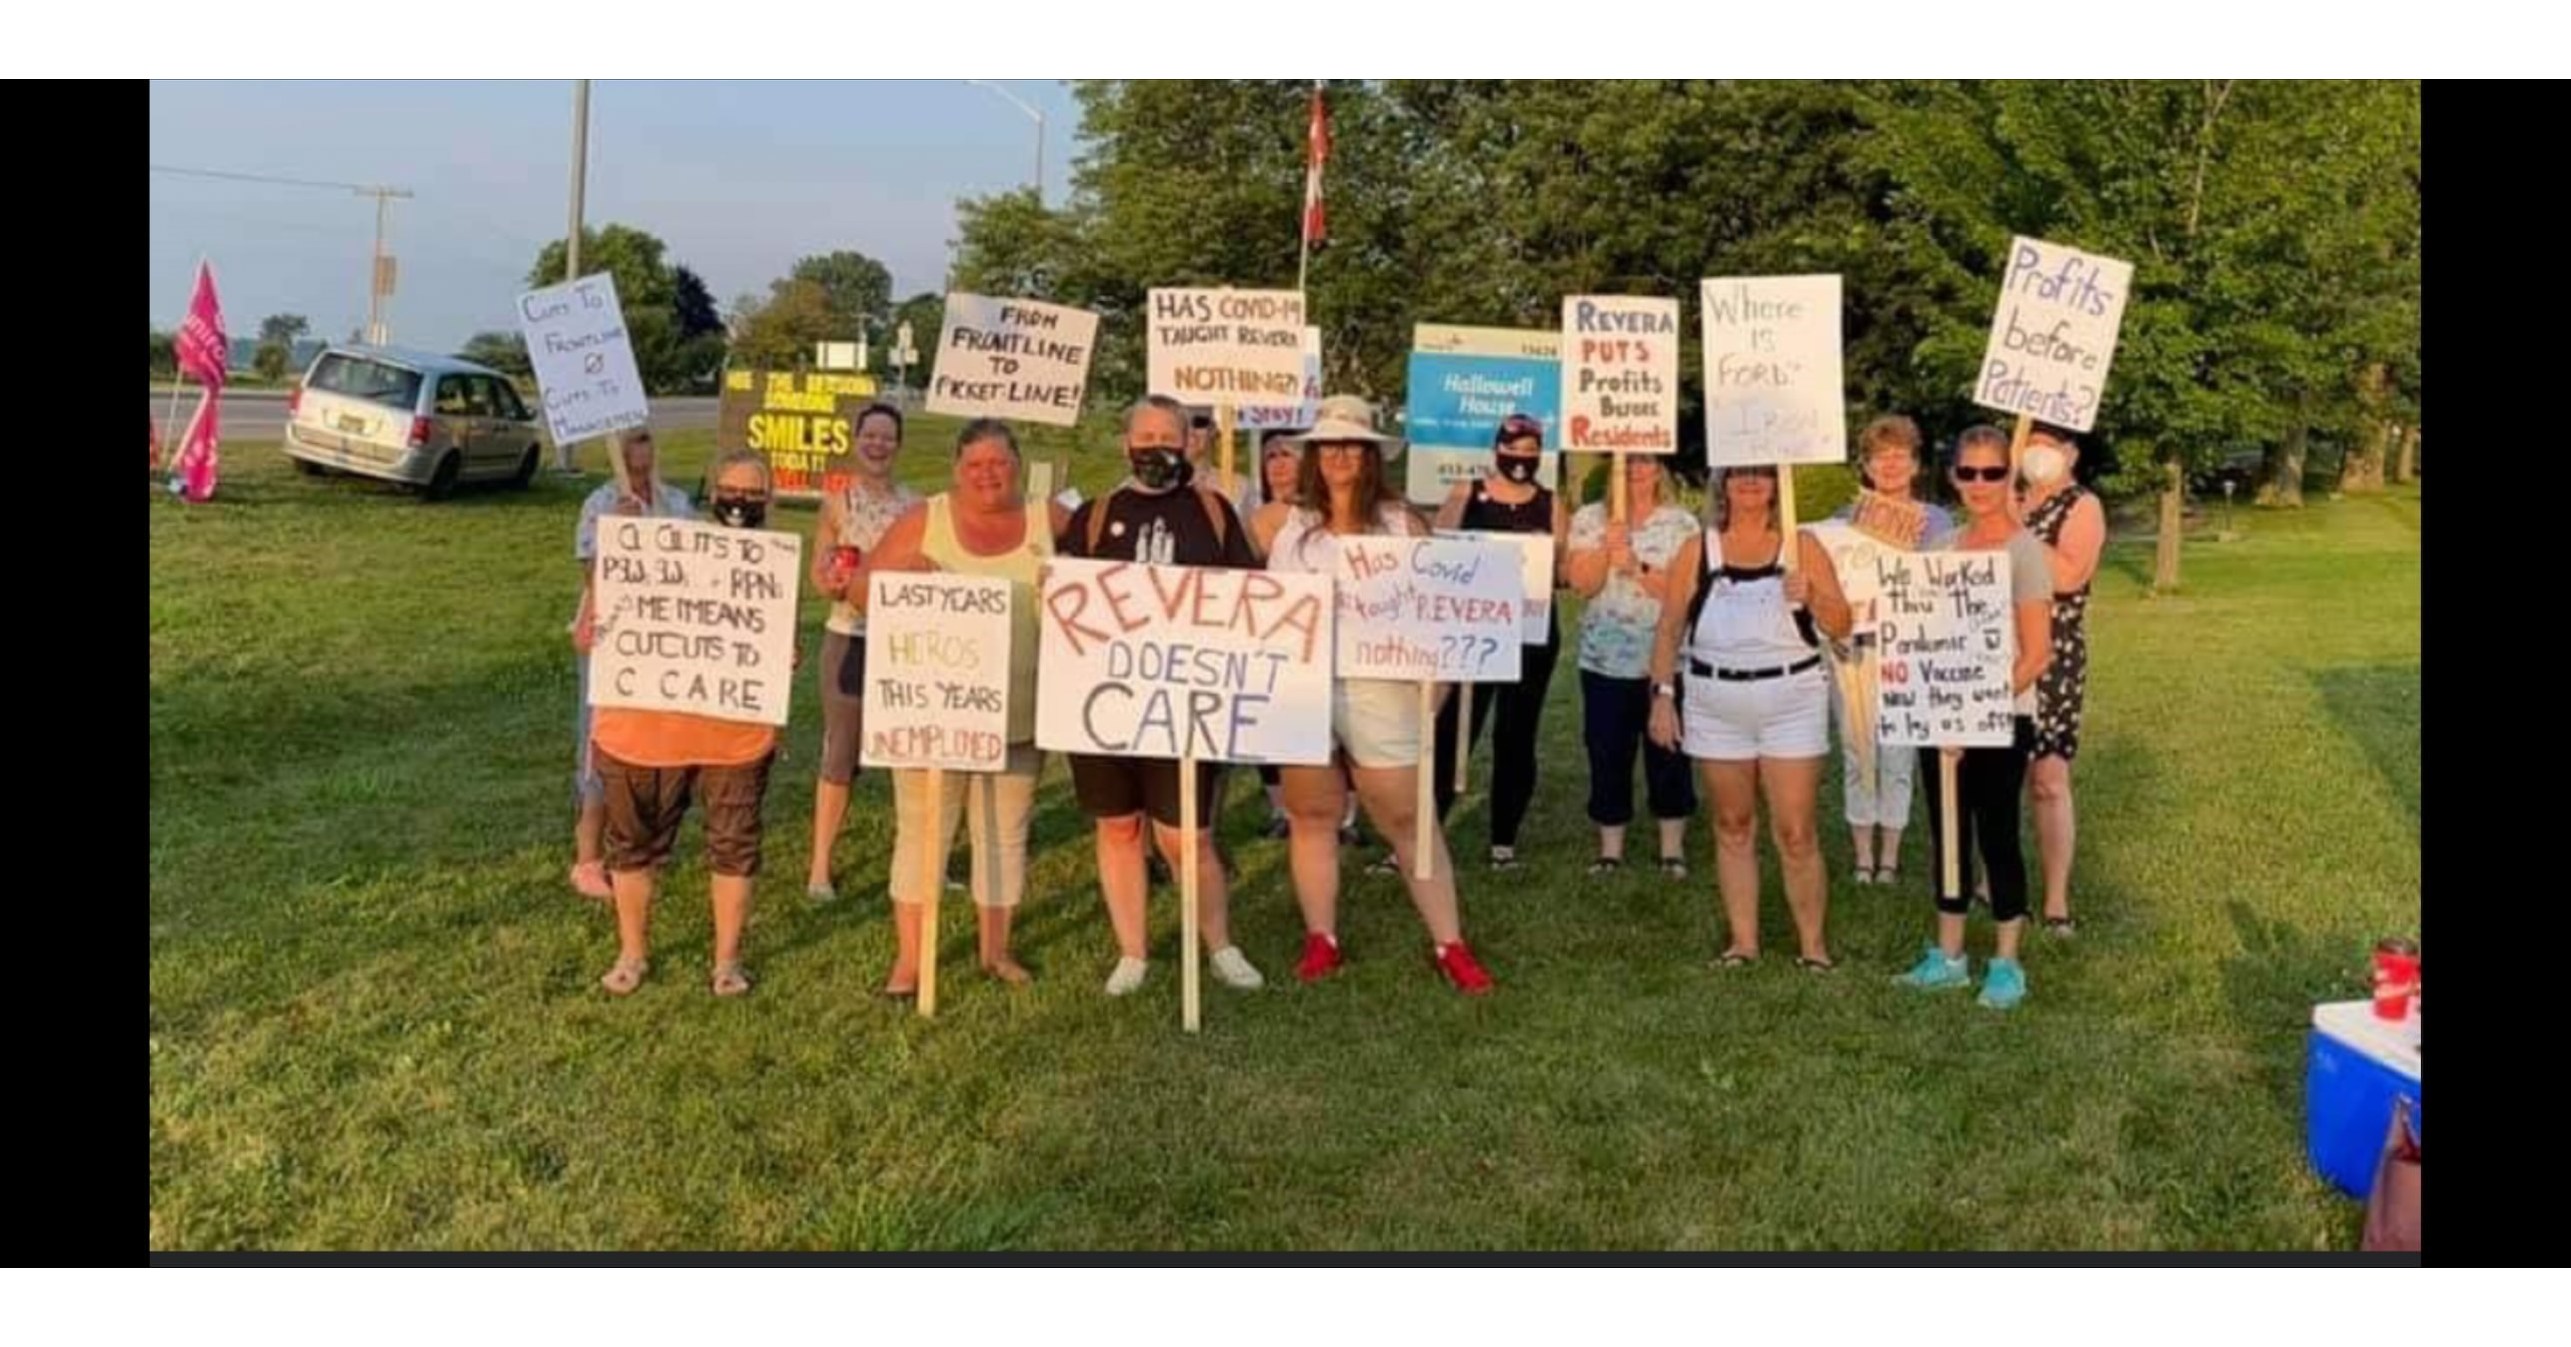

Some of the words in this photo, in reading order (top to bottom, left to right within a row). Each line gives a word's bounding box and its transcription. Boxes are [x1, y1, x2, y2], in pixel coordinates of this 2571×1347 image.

[2008, 245, 2113, 316] Profits
[1000, 306, 1058, 330] FROM
[1156, 292, 1212, 323] HAS
[1576, 300, 1675, 334] REVERA
[1704, 283, 1806, 325] Where
[951, 325, 1085, 366] FRONTLINE
[1157, 324, 1230, 346] TAUGHT
[1581, 338, 1651, 364] PUTS
[2004, 304, 2099, 370] before
[988, 356, 1020, 376] TO
[1578, 367, 1664, 395] Profits
[1982, 358, 2096, 425] Patients?
[747, 413, 850, 455] SMILES
[1570, 415, 1672, 449] Residents
[736, 537, 765, 565] TO
[1343, 542, 1399, 580] Has
[1410, 540, 1481, 585] Covid
[1878, 554, 1912, 587] We
[879, 582, 934, 608] LAST
[935, 585, 1007, 615] YEARS
[1046, 561, 1323, 664] REVERA
[1416, 593, 1513, 626] REVERA
[730, 640, 761, 668] TO
[1106, 639, 1289, 694] DOESN'T
[659, 668, 765, 712] CARE
[1881, 662, 1909, 684] NO
[877, 678, 927, 710] THIS
[935, 680, 1003, 713] YEARS
[1082, 681, 1271, 763] CARE
